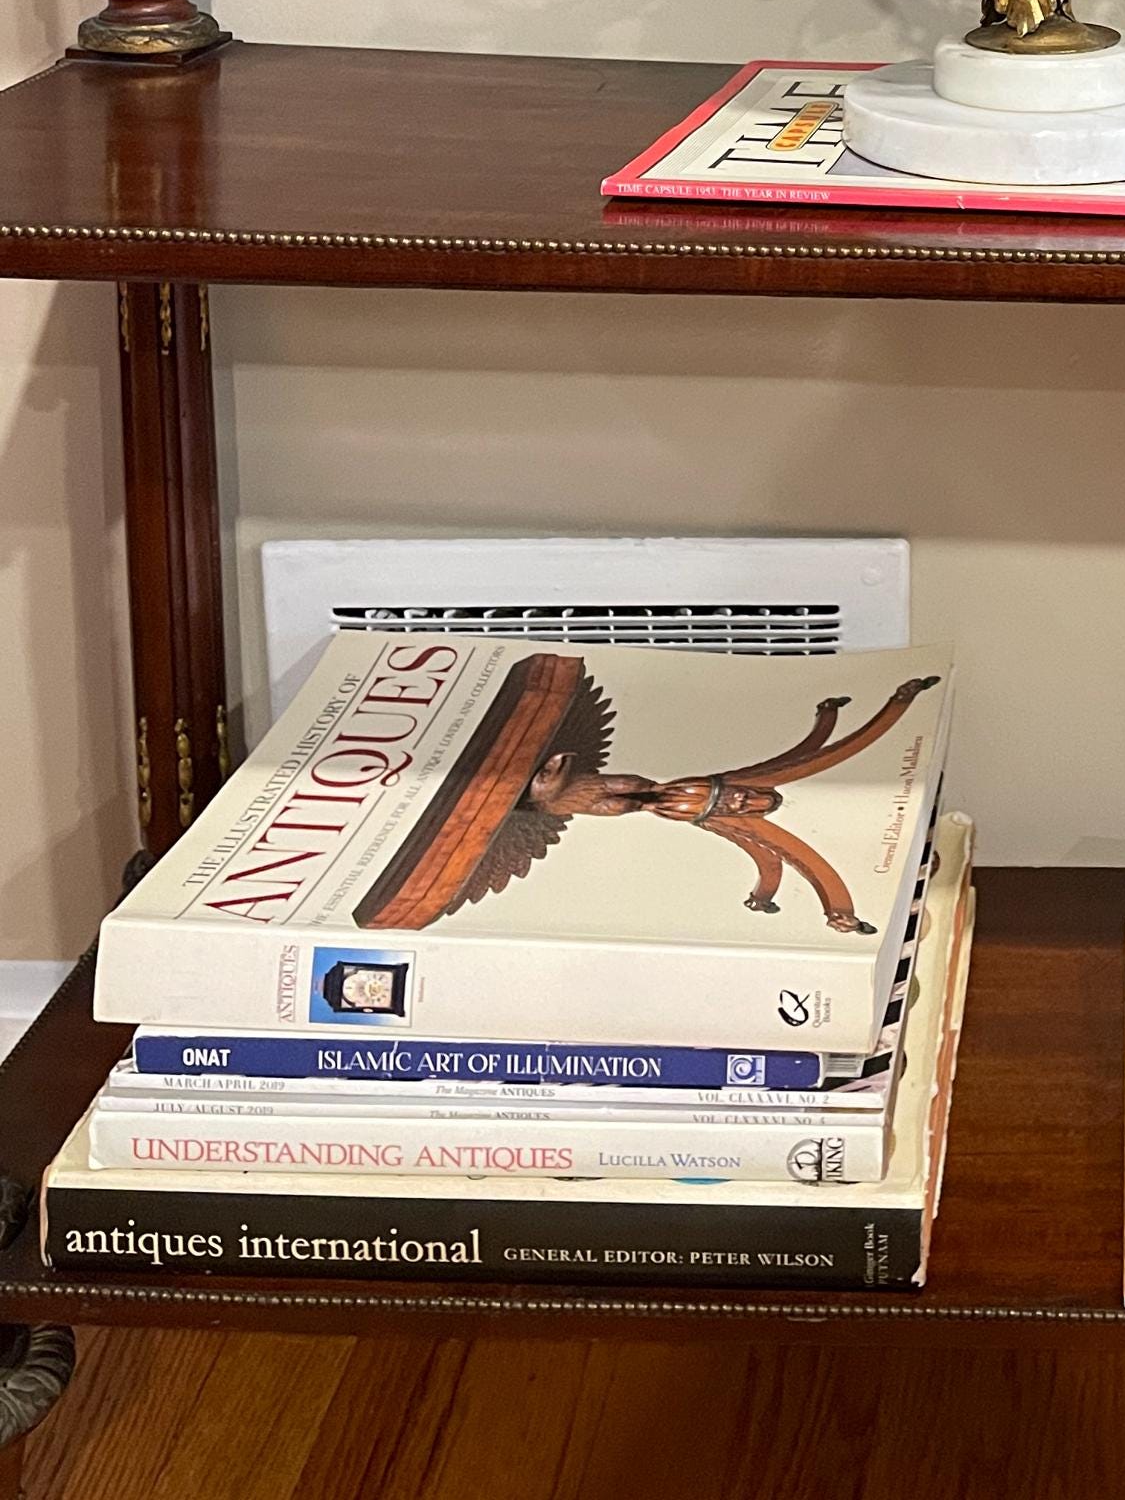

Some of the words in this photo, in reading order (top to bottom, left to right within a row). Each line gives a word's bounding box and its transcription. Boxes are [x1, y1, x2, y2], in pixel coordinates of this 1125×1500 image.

[775, 103, 828, 149] CAPSULE
[617, 184, 641, 193] TIME
[645, 185, 692, 195] CAPSULE
[721, 187, 741, 197] THE
[745, 188, 772, 198] YEAR
[776, 189, 786, 198] IN
[789, 189, 831, 200] REVIEW
[181, 857, 226, 886] THE
[212, 760, 302, 853] ILLUSTRATED
[290, 696, 350, 755] HISTORY
[335, 673, 364, 693] OF
[201, 644, 458, 924] ANTIQUES
[324, 869, 365, 911] ESSENTIAL
[358, 821, 399, 866] REFERENCE
[392, 802, 411, 817] FOR
[404, 785, 423, 800] ALL
[416, 748, 447, 782] ANTIQUE
[458, 699, 476, 716] AND
[471, 646, 506, 696] COLLECTORS
[884, 814, 905, 841] Editor
[874, 842, 897, 873] General
[279, 945, 297, 1023] ANTIQUES
[812, 990, 823, 1028] Quantum
[823, 997, 832, 1022] Books
[182, 1047, 231, 1067] ONAT
[317, 1050, 411, 1072] ISLAMIC
[417, 1051, 463, 1074] ART
[468, 1053, 500, 1074] OF
[506, 1054, 662, 1077] ILLUMINATION
[259, 1080, 285, 1090] 2019
[436, 1085, 452, 1094] The
[501, 1087, 556, 1097] ANTIQUES
[823, 1094, 830, 1104] 2
[496, 1112, 551, 1120] ANTIQUES
[132, 1138, 402, 1166] UNDERSTANDING
[414, 1145, 573, 1172] ANTIQUES
[825, 1137, 844, 1180] IKING
[64, 1218, 224, 1266] antiques
[238, 1223, 483, 1264] international
[863, 1223, 875, 1249] Book
[503, 1248, 598, 1264] GENERAL
[604, 1250, 684, 1265] EDITOR:
[690, 1251, 751, 1266] PETER
[757, 1253, 835, 1268] WILSON
[877, 1234, 889, 1284] PUTNAM
